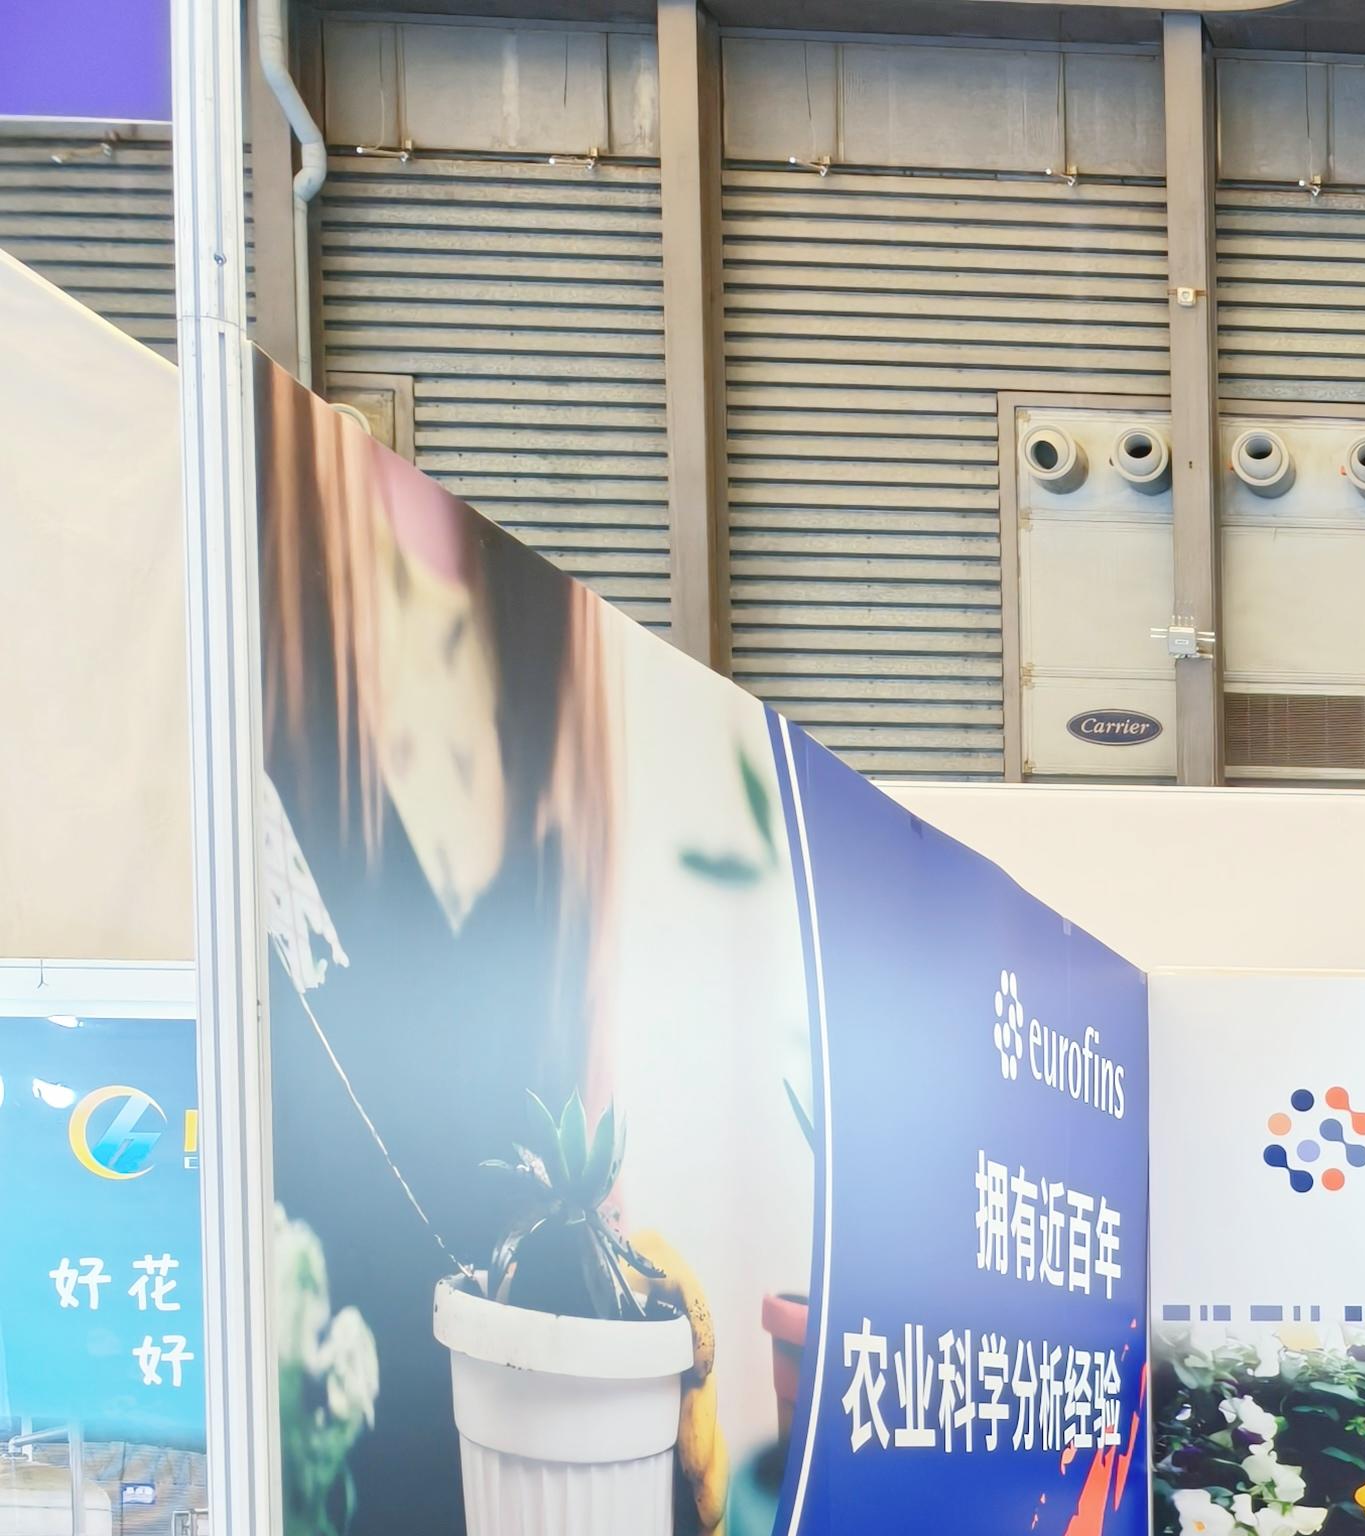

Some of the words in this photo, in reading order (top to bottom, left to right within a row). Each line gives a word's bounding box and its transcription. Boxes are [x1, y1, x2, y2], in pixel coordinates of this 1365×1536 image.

[1080, 717, 1150, 734] Carrier
[1028, 1016, 1126, 1120] eurofins
[974, 1149, 1122, 1299] 拥有近百年
[49, 1253, 182, 1311] 好花
[131, 1335, 195, 1388] 好
[842, 1317, 1122, 1454] 农业科学分析经验
